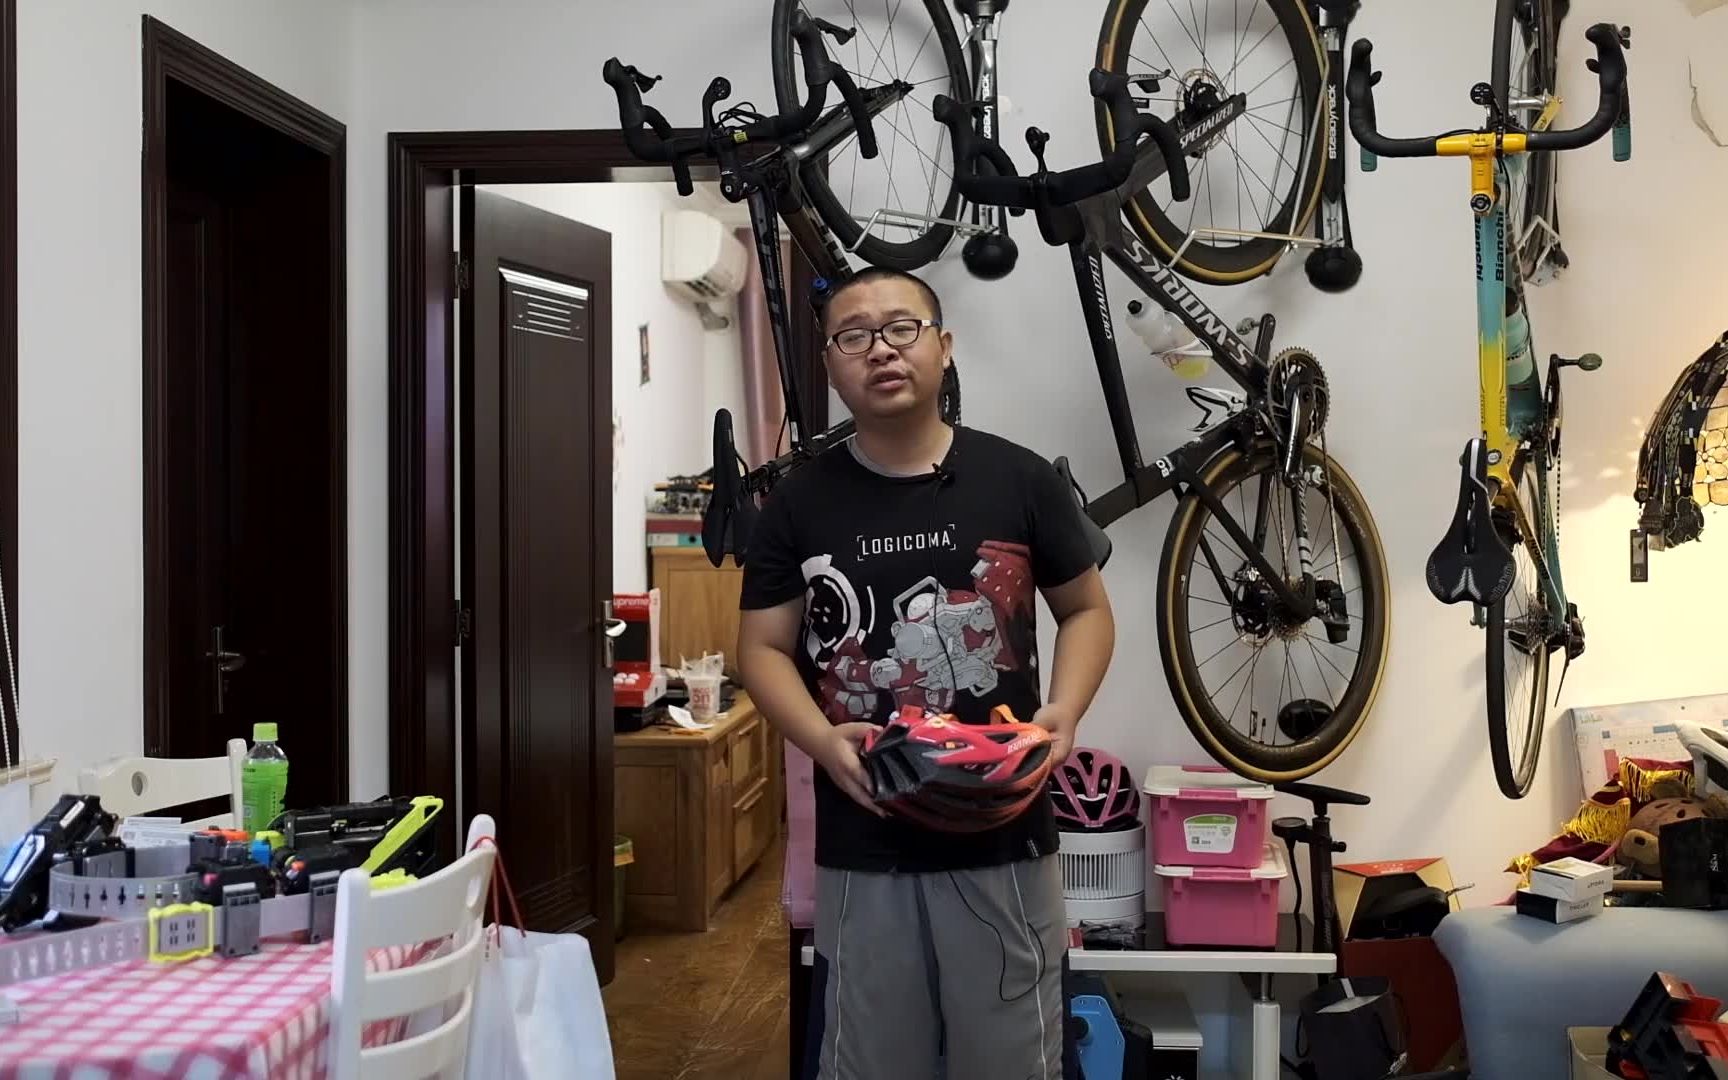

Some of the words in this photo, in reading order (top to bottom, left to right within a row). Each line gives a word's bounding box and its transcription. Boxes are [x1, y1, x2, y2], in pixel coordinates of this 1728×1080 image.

[1180, 103, 1233, 149] SPECIALIZED
[1328, 84, 1339, 159] steadyrack
[1496, 211, 1504, 281] Bianchi
[1123, 239, 1255, 366] S-WORKS
[862, 530, 951, 556] LOGICOMA
